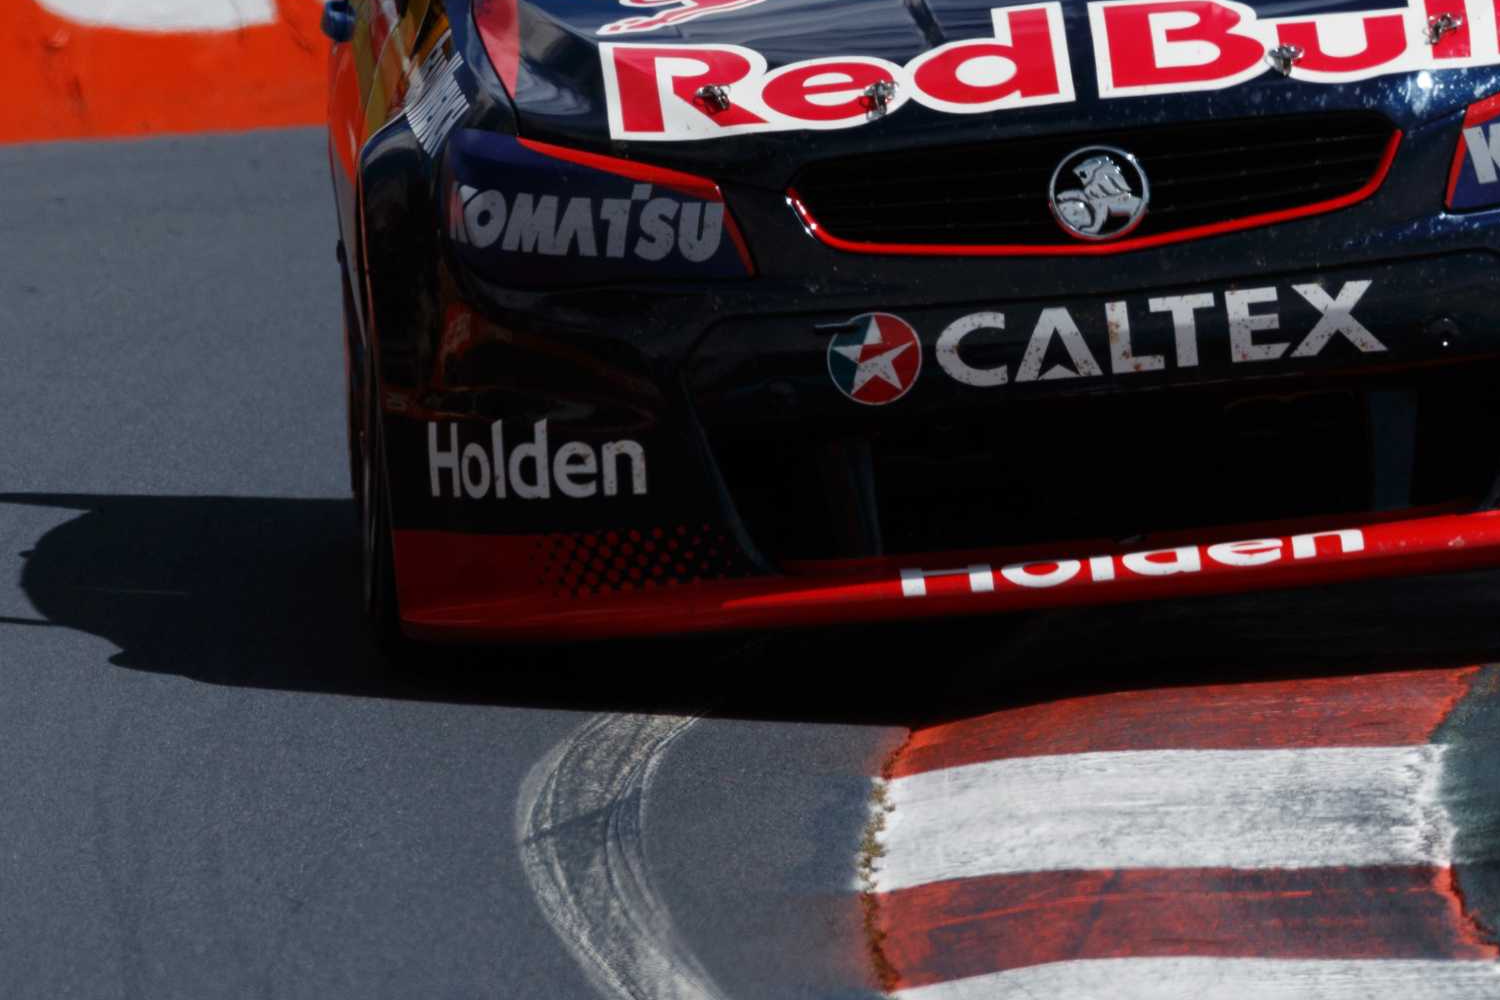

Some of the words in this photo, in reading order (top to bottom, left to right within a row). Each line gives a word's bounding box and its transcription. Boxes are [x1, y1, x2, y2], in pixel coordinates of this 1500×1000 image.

[598, 1, 1076, 141] Red
[450, 182, 726, 263] KOMATSU
[936, 279, 1387, 387] CALTEX
[428, 418, 647, 499] Holden
